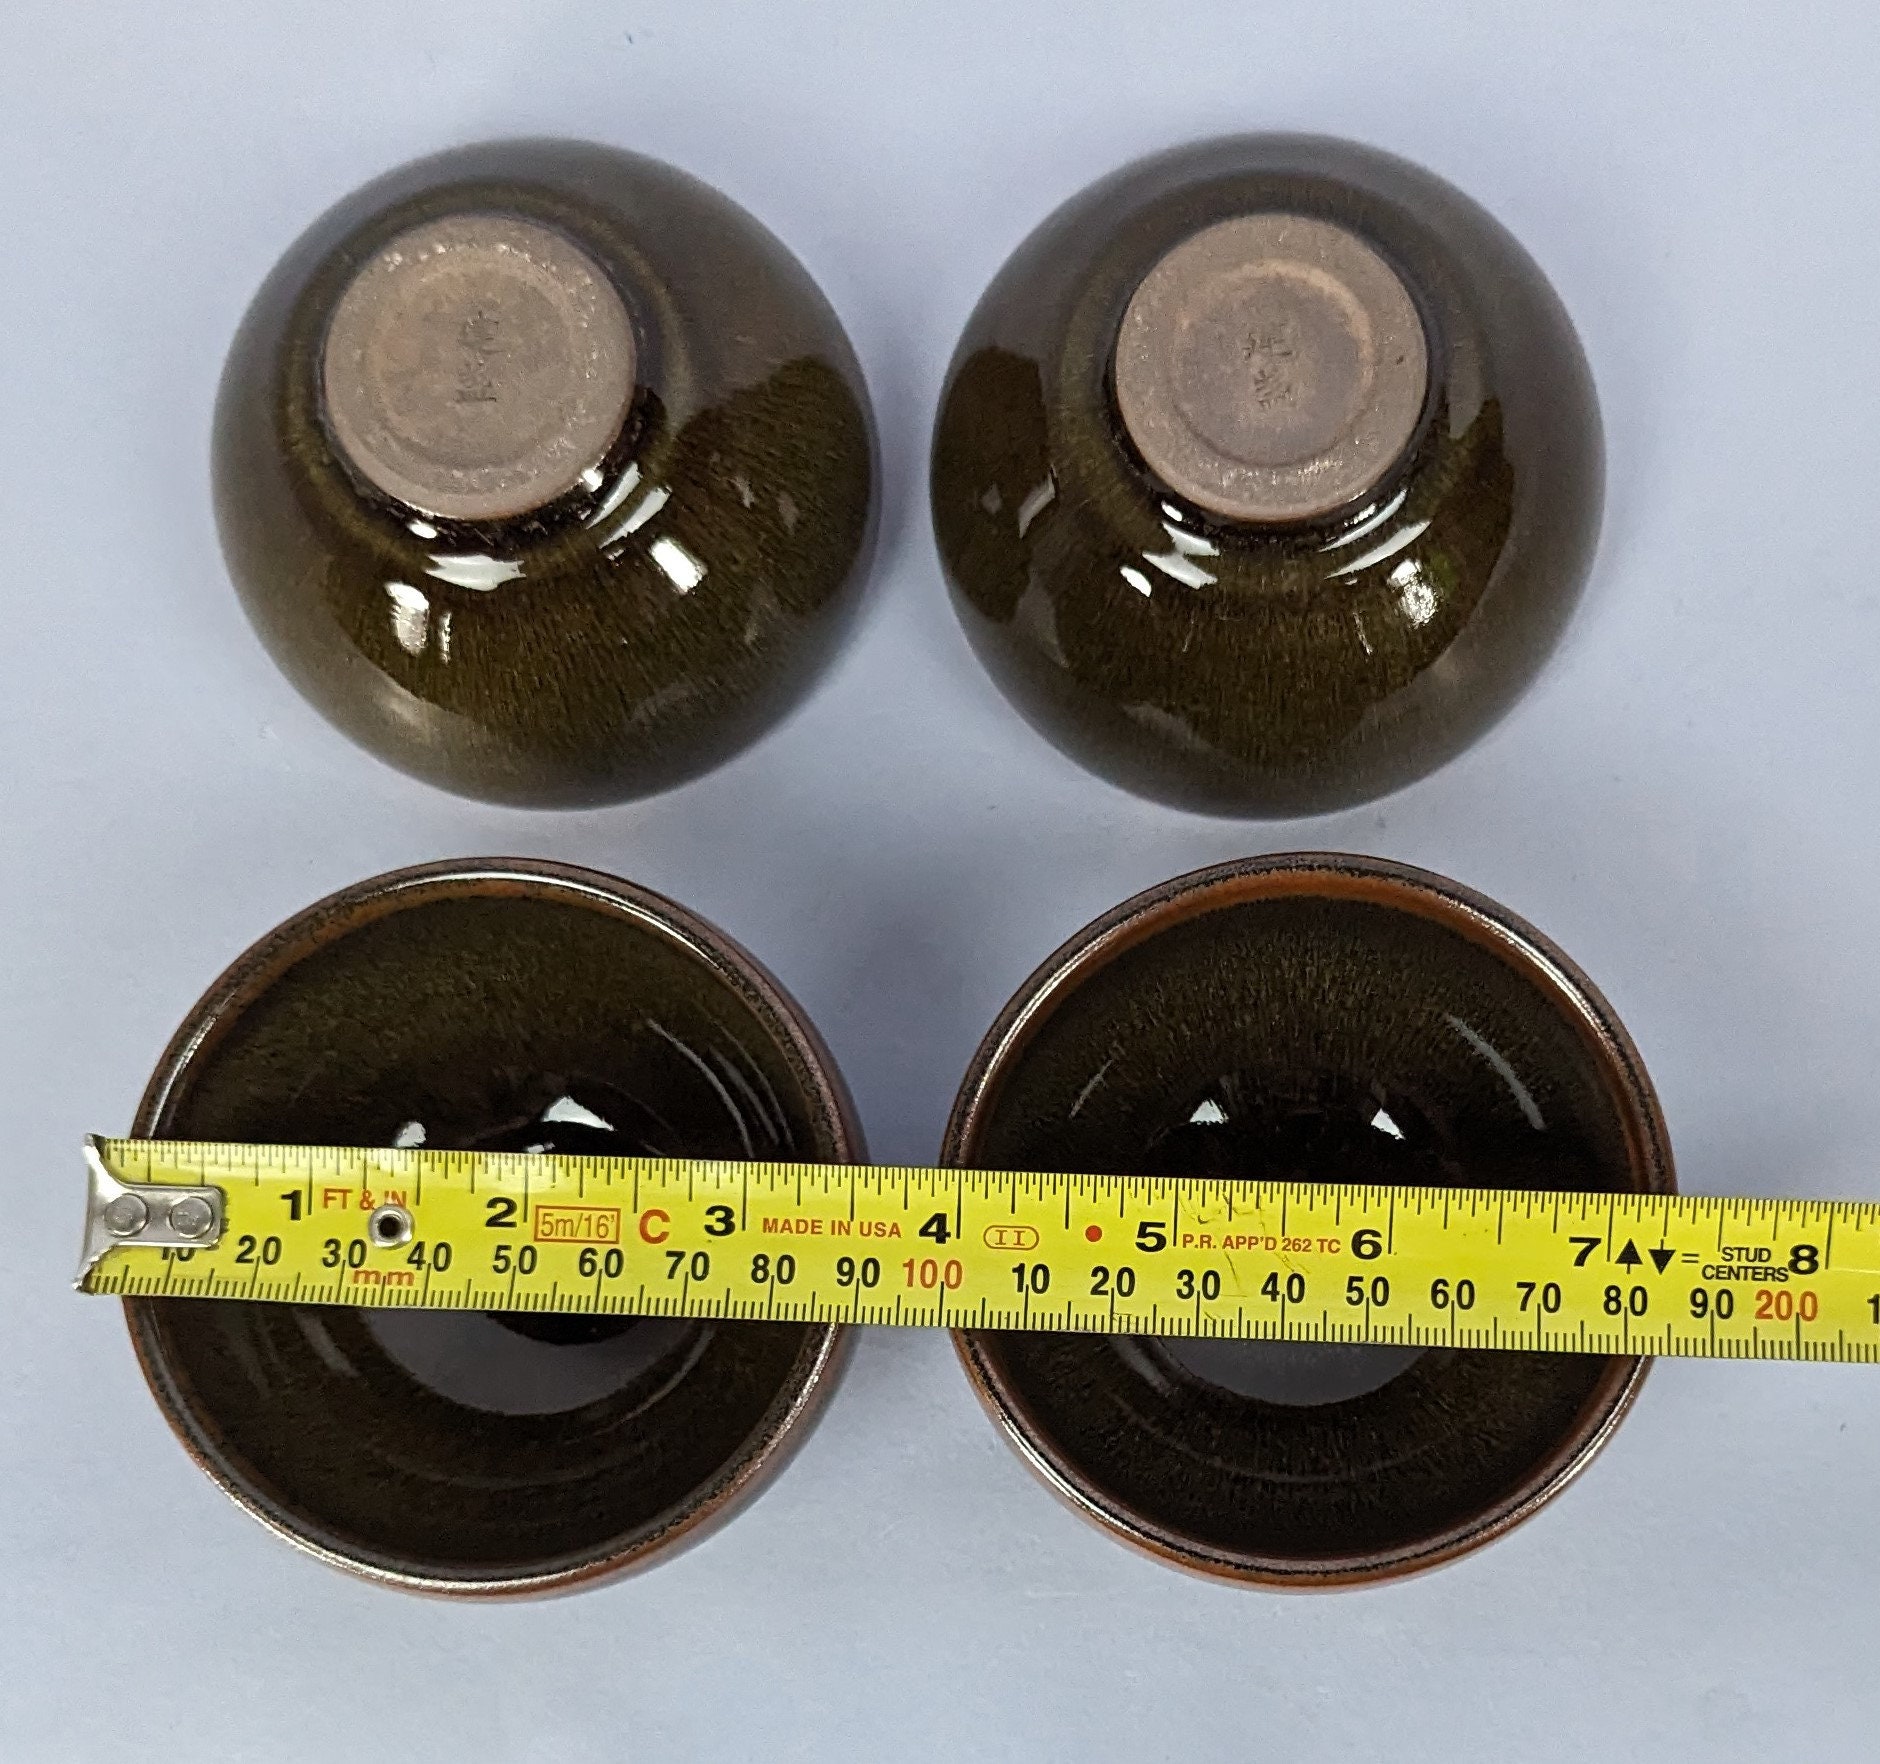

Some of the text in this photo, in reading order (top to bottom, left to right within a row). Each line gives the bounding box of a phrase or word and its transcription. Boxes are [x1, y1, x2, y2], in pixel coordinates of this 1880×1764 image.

[281, 1189, 303, 1221] 1
[323, 1188, 353, 1210] FT
[359, 1189, 376, 1211] &
[485, 1197, 517, 1228] 2
[639, 1209, 671, 1244] C
[704, 1205, 736, 1236] 3
[762, 1217, 902, 1238] MADE IN USA
[918, 1212, 952, 1244] 4
[236, 1235, 282, 1265] 20
[1135, 1221, 1167, 1252] 5
[1182, 1234, 1341, 1254] P.R. APP'D 262 TC
[1351, 1229, 1383, 1260] 6
[1568, 1237, 1601, 1267] 7
[322, 1238, 367, 1269] 30
[407, 1240, 452, 1272] 40
[493, 1243, 538, 1275] 50
[579, 1247, 624, 1278] 60
[665, 1250, 711, 1282] 70
[751, 1253, 796, 1285] 80
[1721, 1246, 1771, 1263] STUD
[1788, 1244, 1819, 1275] 8
[352, 1269, 415, 1287] mm
[837, 1256, 881, 1288] 90
[903, 1258, 963, 1290] 100
[1012, 1262, 1050, 1294] 10
[1091, 1265, 1136, 1297] 20
[1176, 1269, 1221, 1300] 30
[1261, 1272, 1306, 1303] 40
[1702, 1264, 1789, 1283] CENTERS
[1346, 1275, 1390, 1307] 50
[1431, 1278, 1475, 1310] 60
[1515, 1281, 1561, 1313] 70
[1603, 1284, 1648, 1316] 80
[1690, 1287, 1734, 1319] 90
[1754, 1290, 1818, 1322] 200
